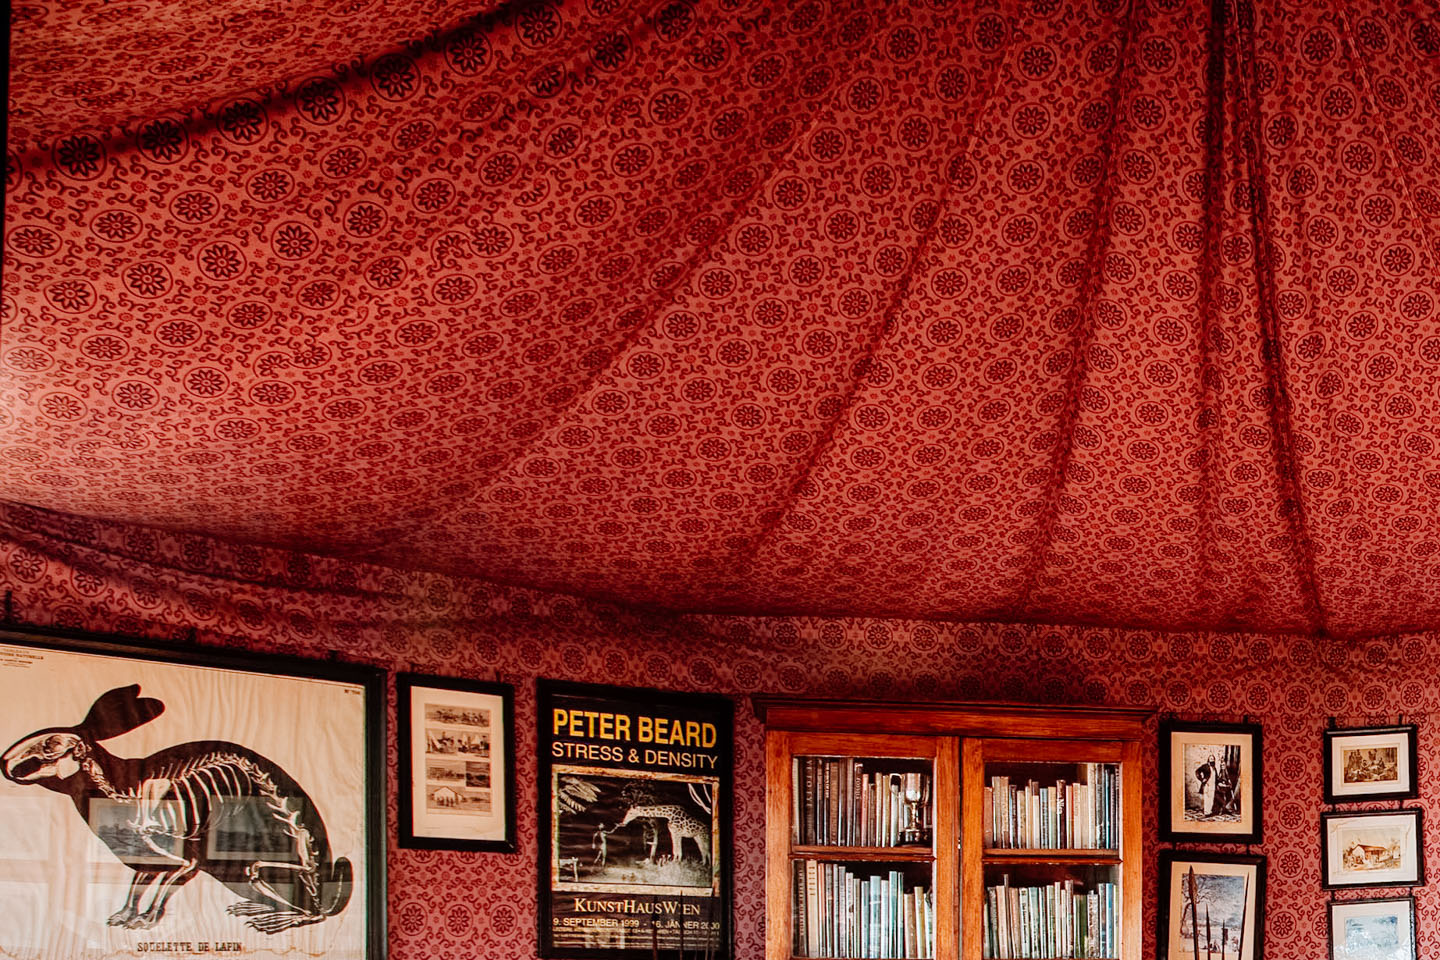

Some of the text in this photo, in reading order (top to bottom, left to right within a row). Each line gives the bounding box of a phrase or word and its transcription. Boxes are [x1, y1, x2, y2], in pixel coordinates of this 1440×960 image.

[553, 708, 717, 748] PETER BEARD
[552, 741, 718, 769] STRESS & DENSITY
[562, 918, 618, 927] SEPTEMBER
[137, 942, 242, 952] SQUELETTE DE LAPIN
